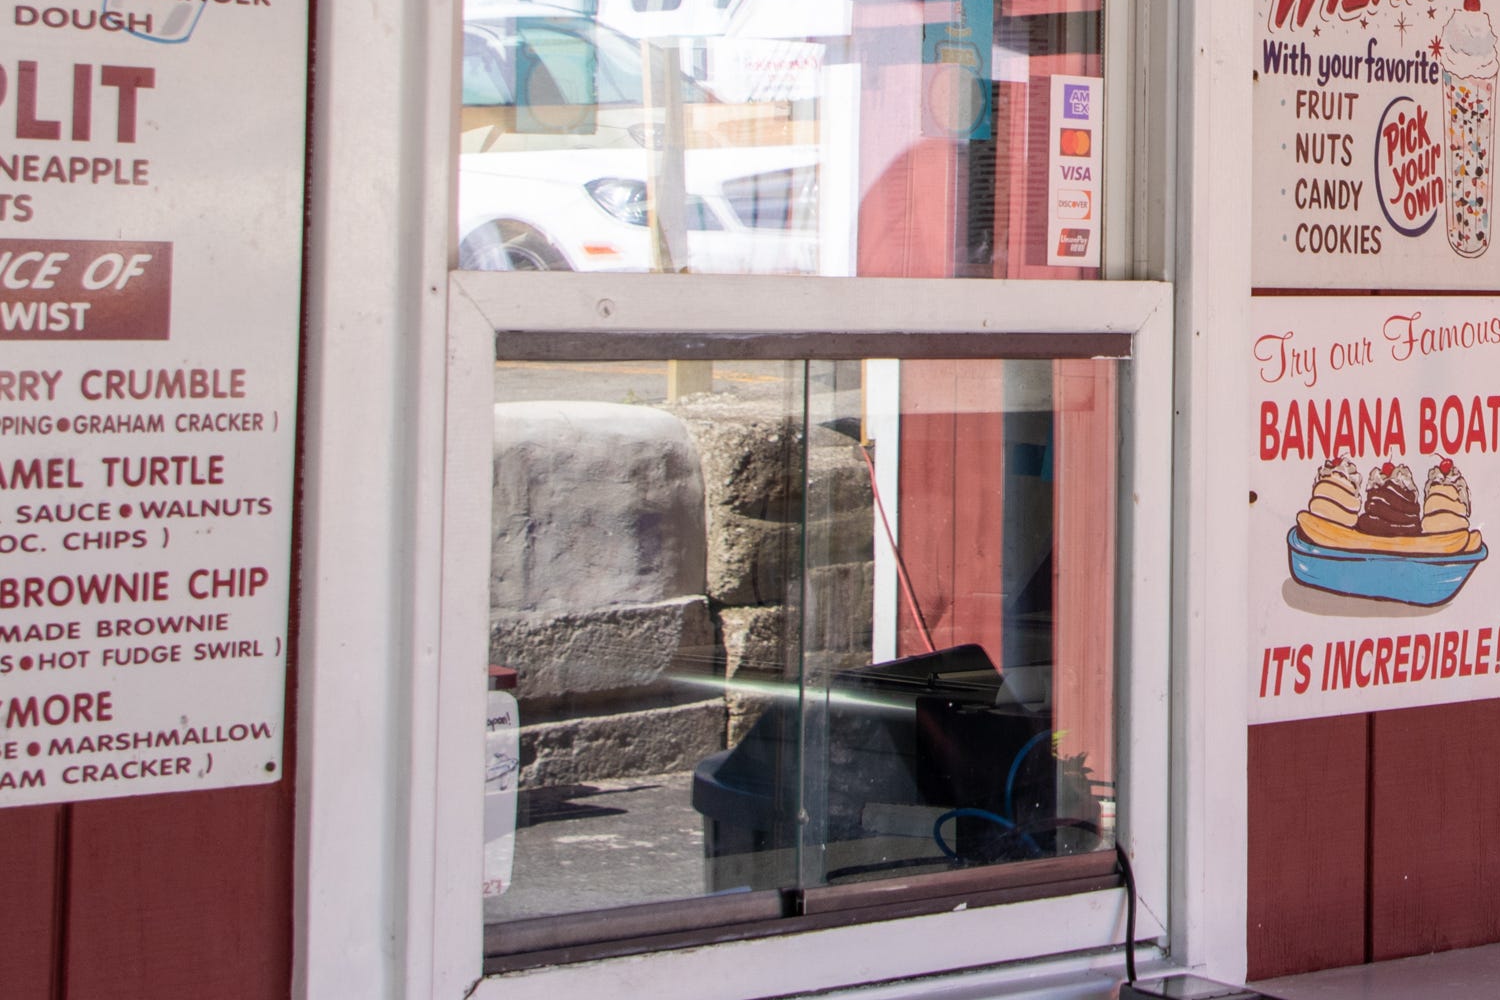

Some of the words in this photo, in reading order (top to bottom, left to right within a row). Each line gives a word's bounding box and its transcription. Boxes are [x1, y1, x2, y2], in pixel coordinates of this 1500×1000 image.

[14, 5, 153, 33] DOUGH
[1263, 38, 1312, 77] With
[1318, 53, 1365, 87] your
[1364, 37, 1440, 86] favorite
[1072, 90, 1089, 102] AM
[1073, 102, 1089, 113] EX
[1295, 89, 1359, 121] FRUIT
[1295, 133, 1354, 167] NUTS
[1060, 165, 1092, 181] VISA
[1294, 177, 1363, 212] CANDY
[1294, 224, 1382, 256] COOKIES
[81, 368, 246, 401] CRUMBLE
[1259, 396, 1406, 462] BANANA
[102, 455, 225, 487] TURTLE
[189, 567, 269, 600] CHIP
[1258, 642, 1315, 699] IT'S
